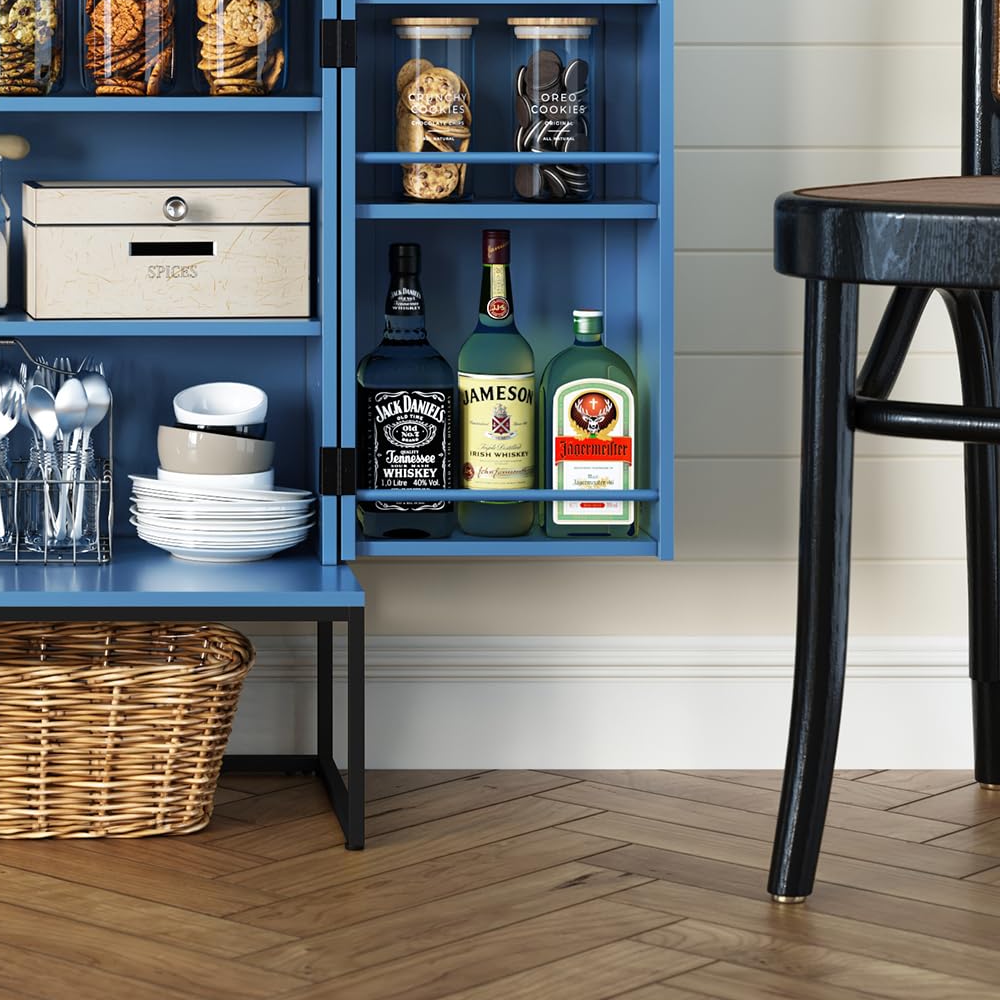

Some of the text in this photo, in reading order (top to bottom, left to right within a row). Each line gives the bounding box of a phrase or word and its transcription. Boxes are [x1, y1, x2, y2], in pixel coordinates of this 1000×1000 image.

[408, 93, 467, 102] CRUNCHY
[541, 93, 577, 102] OREO
[411, 105, 465, 114] COOKIES
[531, 105, 585, 114] COOKIES
[145, 265, 199, 279] SPICES
[463, 385, 534, 406] JAMESON
[375, 394, 446, 423] JACK DANIEL'S
[402, 424, 418, 432] Old
[385, 449, 436, 464] Tennessee
[383, 468, 438, 478] WHISKEY
